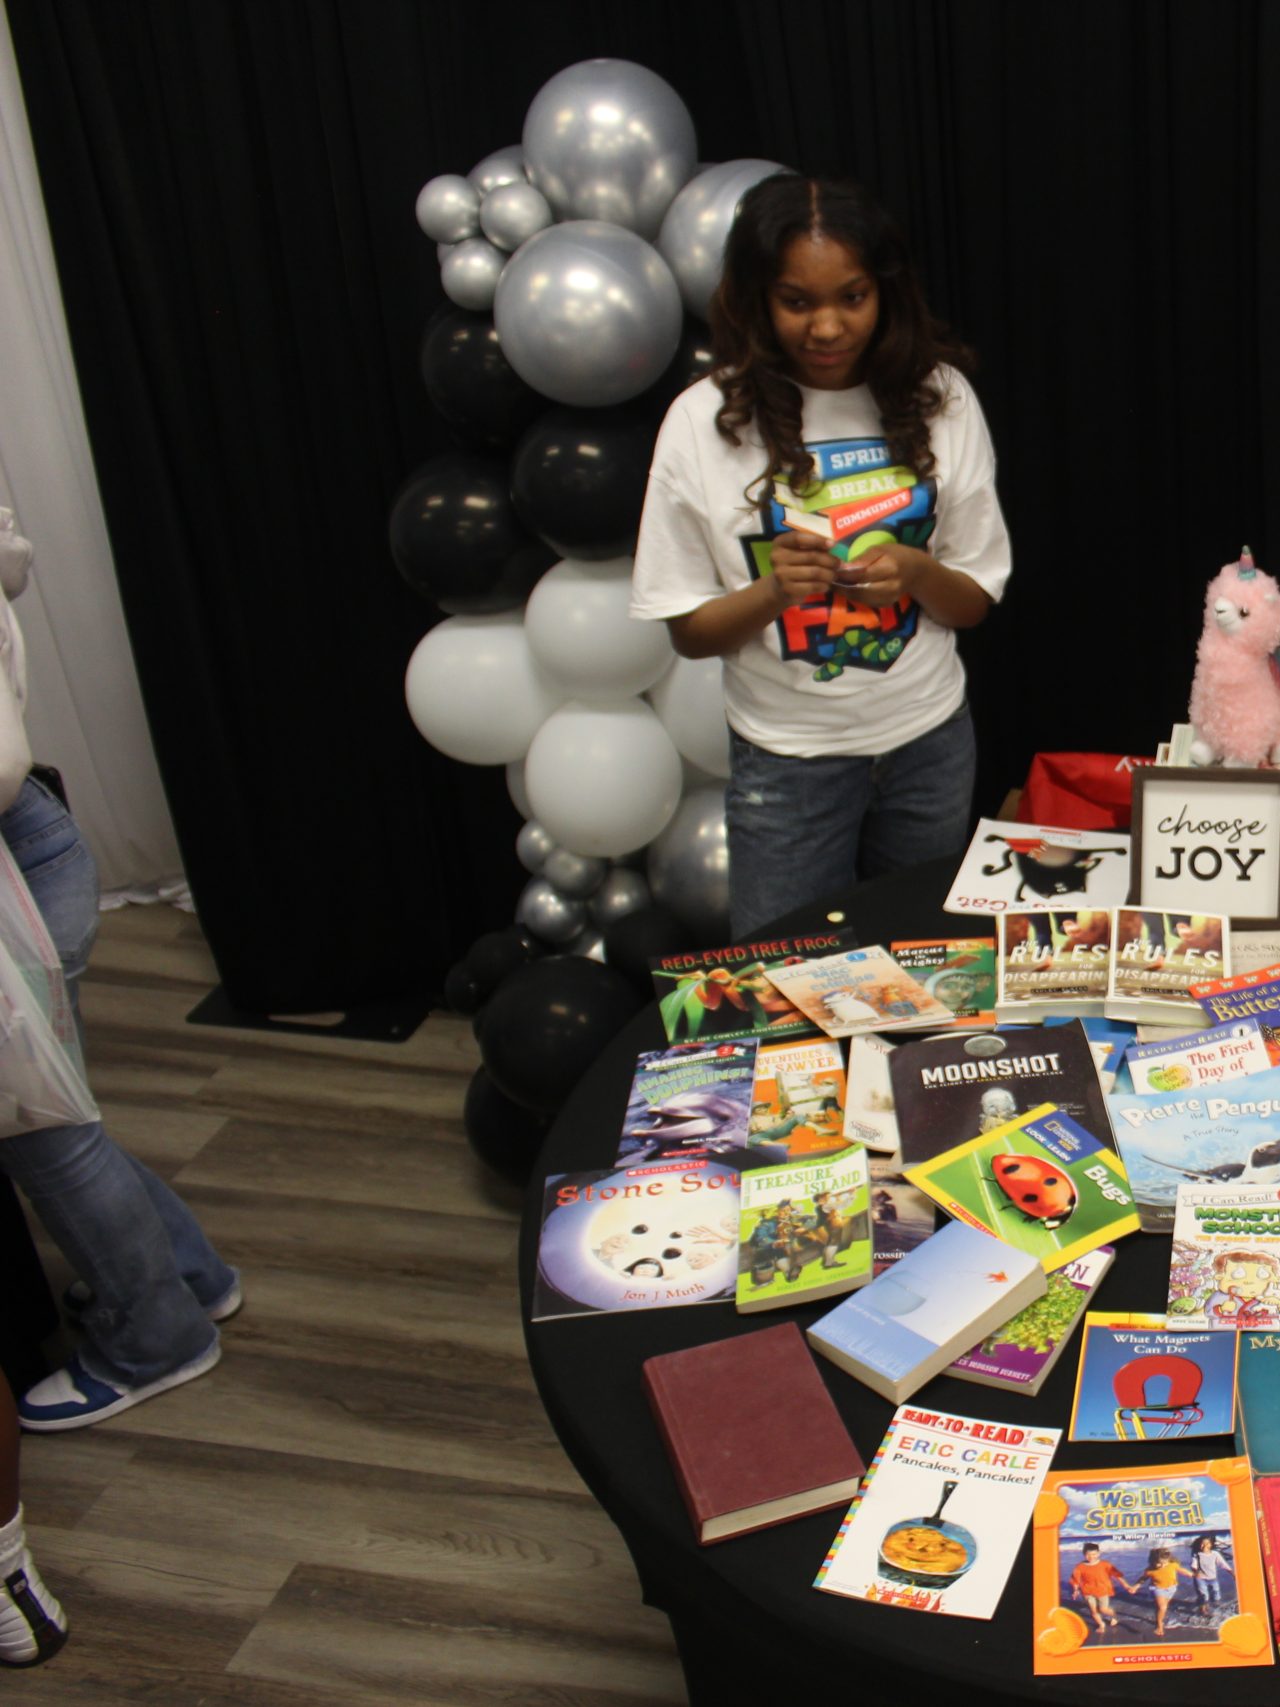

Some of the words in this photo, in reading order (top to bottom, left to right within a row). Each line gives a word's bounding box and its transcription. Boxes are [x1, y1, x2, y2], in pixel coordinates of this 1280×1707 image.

[830, 444, 890, 469] SPRIN
[828, 472, 900, 500] BREAK
[835, 492, 910, 529] COMMUNITY
[1157, 804, 1267, 844] choose
[1155, 846, 1266, 881] JOY
[660, 947, 747, 970] RED-EYED
[749, 940, 792, 958] TREE
[793, 935, 841, 953] FROG
[899, 956, 945, 968] Mighty
[1009, 943, 1109, 964] RULES
[1120, 942, 1220, 968] RULES
[1207, 996, 1231, 1007] The
[1232, 990, 1254, 1002] Life
[1256, 985, 1269, 997] of
[1269, 986, 1278, 994] a
[757, 1049, 824, 1065] DVENTURES
[1187, 1051, 1216, 1065] The
[1218, 1039, 1255, 1058] First
[776, 1057, 838, 1073] SAWYER
[921, 1052, 1060, 1085] MOONSHOT
[1198, 1064, 1226, 1080] Day
[1230, 1058, 1245, 1072] of
[1119, 1098, 1200, 1128] Pierre
[1190, 1112, 1205, 1120] the
[1025, 1127, 1045, 1145] LOOK
[1047, 1144, 1072, 1162] LEARN
[1183, 1133, 1190, 1141] A
[1215, 1126, 1240, 1136] Story
[638, 1161, 706, 1176] SCHOLASTIC
[755, 1166, 834, 1191] TREASURE
[556, 1181, 664, 1207] Stone
[804, 1170, 860, 1195] ISLAND
[1083, 1165, 1131, 1206] Bugs
[1211, 1195, 1235, 1204] Can
[1238, 1193, 1272, 1203] Read!
[873, 1248, 907, 1260] rossin
[620, 1290, 646, 1302] Jon
[653, 1290, 659, 1303] J
[666, 1283, 706, 1299] Muth
[1113, 1334, 1150, 1344] What
[1154, 1334, 1211, 1346] Magnets
[1133, 1345, 1161, 1354] Can
[1166, 1345, 1188, 1354] Do
[898, 1436, 955, 1458] ERIC
[961, 1449, 1040, 1470] CARLE
[892, 1453, 961, 1476] Pancakes,
[965, 1467, 1036, 1485] Pancakes!
[1098, 1490, 1137, 1508] We
[1140, 1487, 1190, 1507] Like
[1084, 1502, 1205, 1531] Summer!
[1125, 1533, 1146, 1541] Wiley
[1123, 1654, 1192, 1663] SCHOLASTIC
